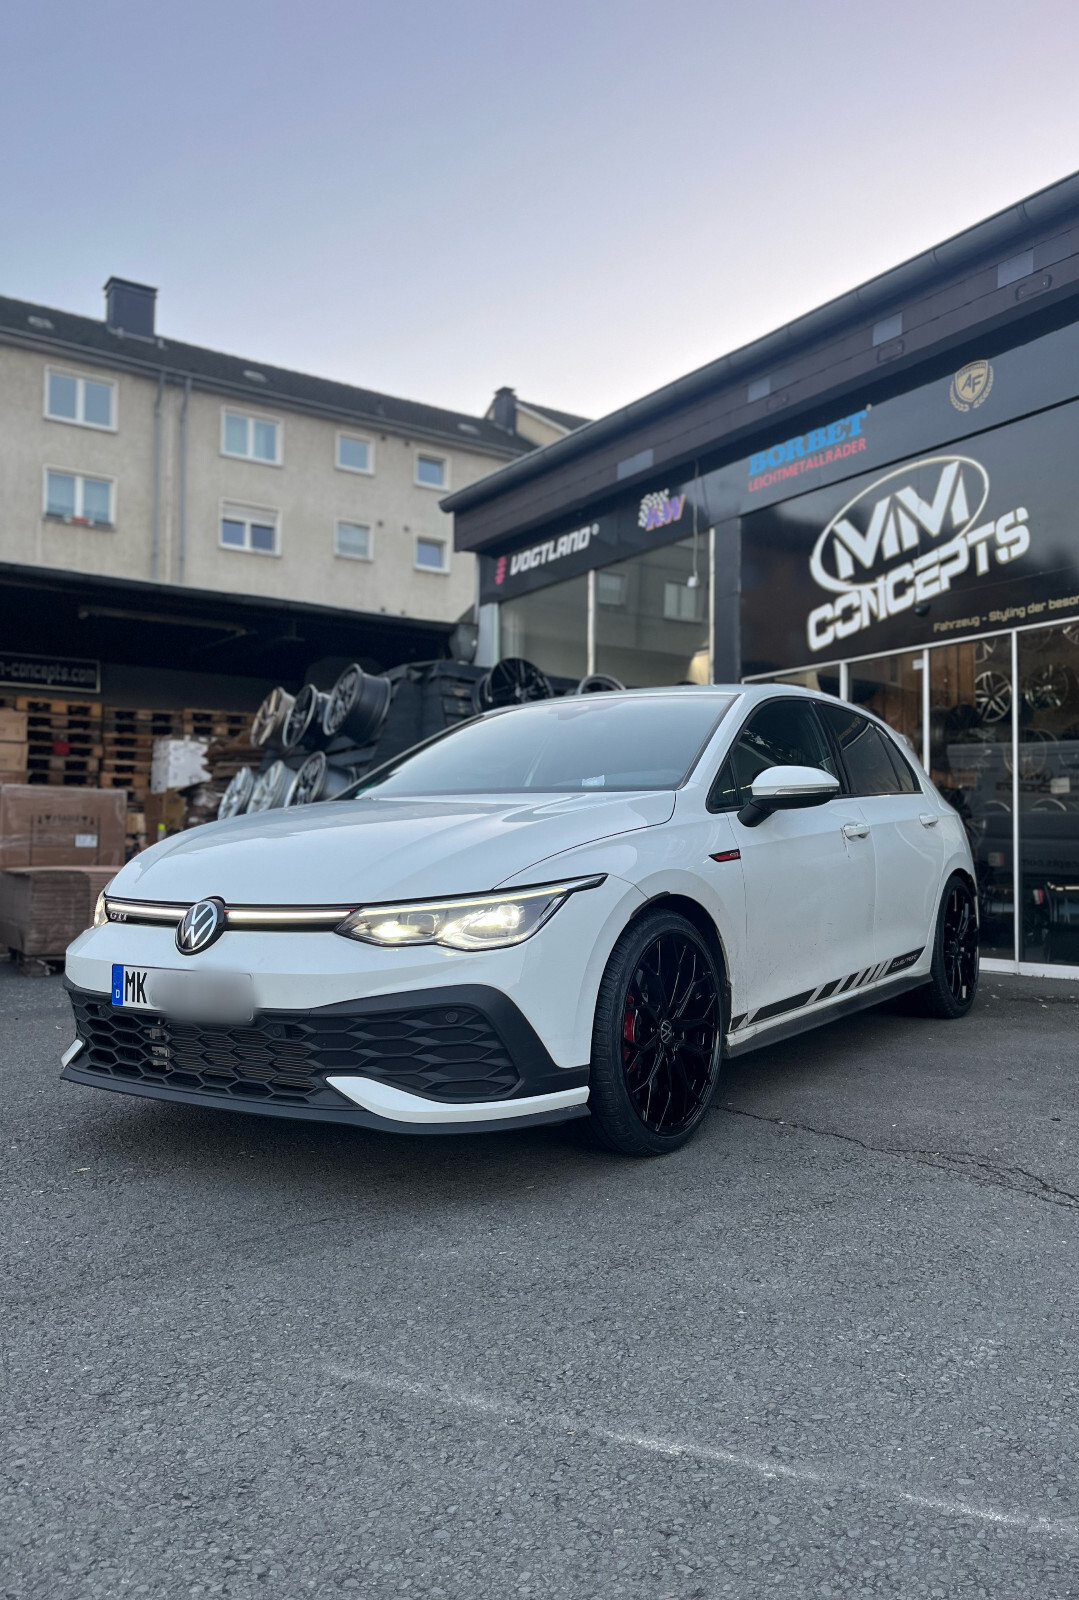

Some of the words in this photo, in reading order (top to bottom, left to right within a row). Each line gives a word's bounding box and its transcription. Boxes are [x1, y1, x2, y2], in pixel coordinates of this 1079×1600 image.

[748, 410, 867, 476] BORBET
[748, 438, 867, 492] LEICHTMETALLRÄDER
[807, 506, 1030, 651] CONCEPTS
[933, 616, 980, 632] Fahrzeug
[988, 607, 1026, 622] Styling
[1027, 602, 1047, 614] der
[109, 911, 127, 921] GTI
[115, 989, 121, 999] D
[124, 970, 148, 1004] MK
